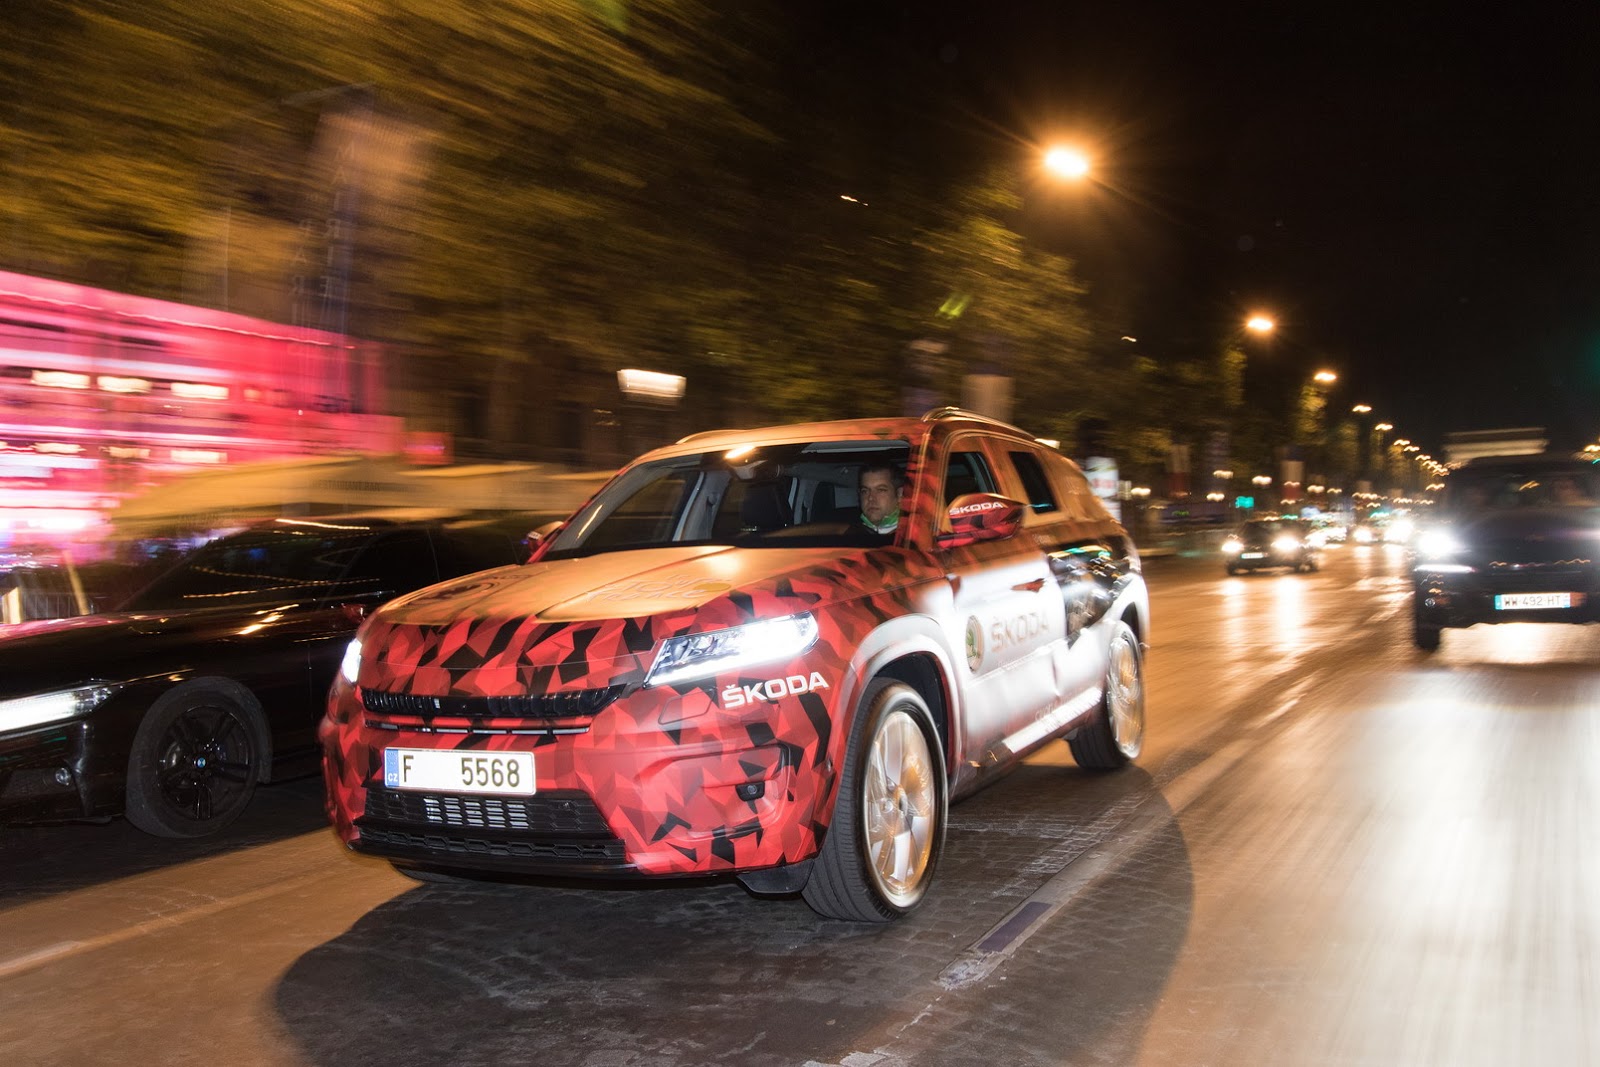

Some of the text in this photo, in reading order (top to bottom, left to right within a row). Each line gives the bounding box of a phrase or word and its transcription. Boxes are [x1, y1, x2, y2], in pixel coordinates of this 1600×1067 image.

[721, 671, 829, 709] ŠKODA
[387, 773, 399, 783] CZ
[403, 755, 520, 788] F 5568
